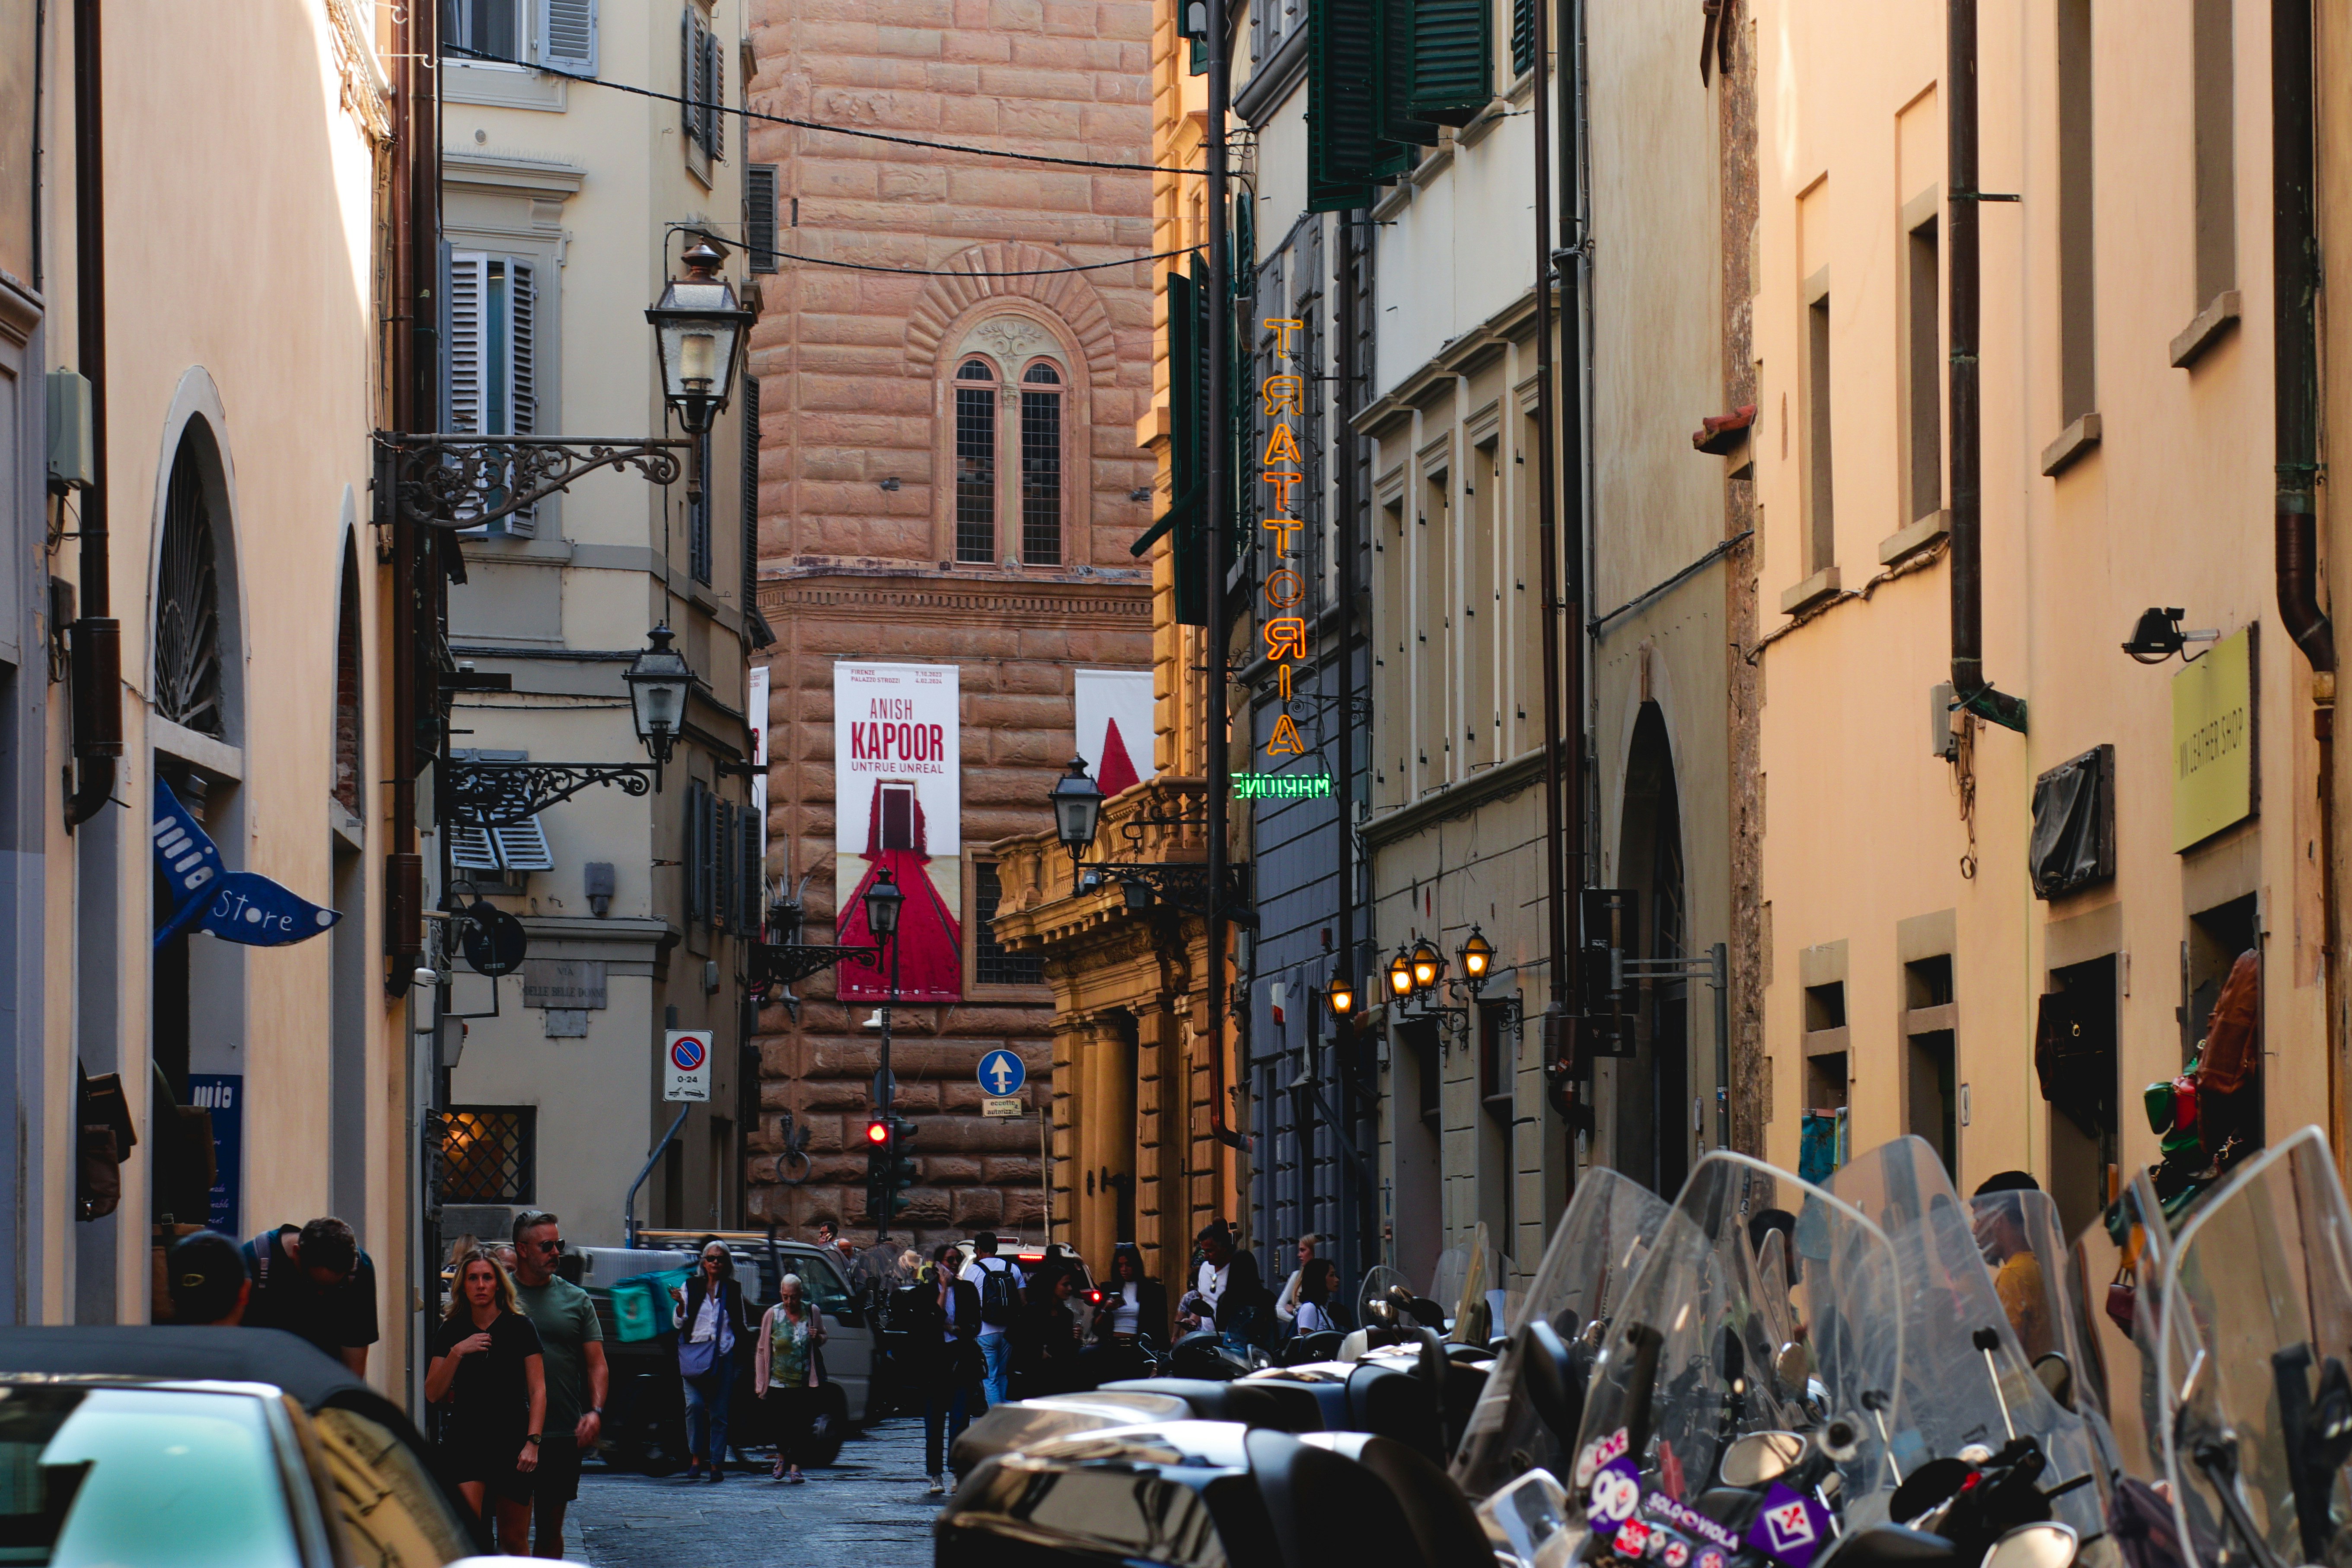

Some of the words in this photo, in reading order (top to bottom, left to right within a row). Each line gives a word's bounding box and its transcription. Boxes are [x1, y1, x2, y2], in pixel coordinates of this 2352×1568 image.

[870, 698, 913, 720] ANISH
[851, 721, 944, 762] KAPOOR
[2189, 720, 2219, 773] LEATHER
[2221, 706, 2243, 755] SHOP
[851, 762, 896, 772] UNTRUE
[900, 762, 944, 774] UNREAL
[212, 889, 293, 932] Store
[558, 967, 574, 976] VIA
[525, 987, 549, 996] DELLE
[552, 987, 575, 997] BELLE
[193, 1080, 233, 1109] mio
[1648, 1491, 1684, 1519] SOLO
[1697, 1515, 1739, 1552] VIOLA
